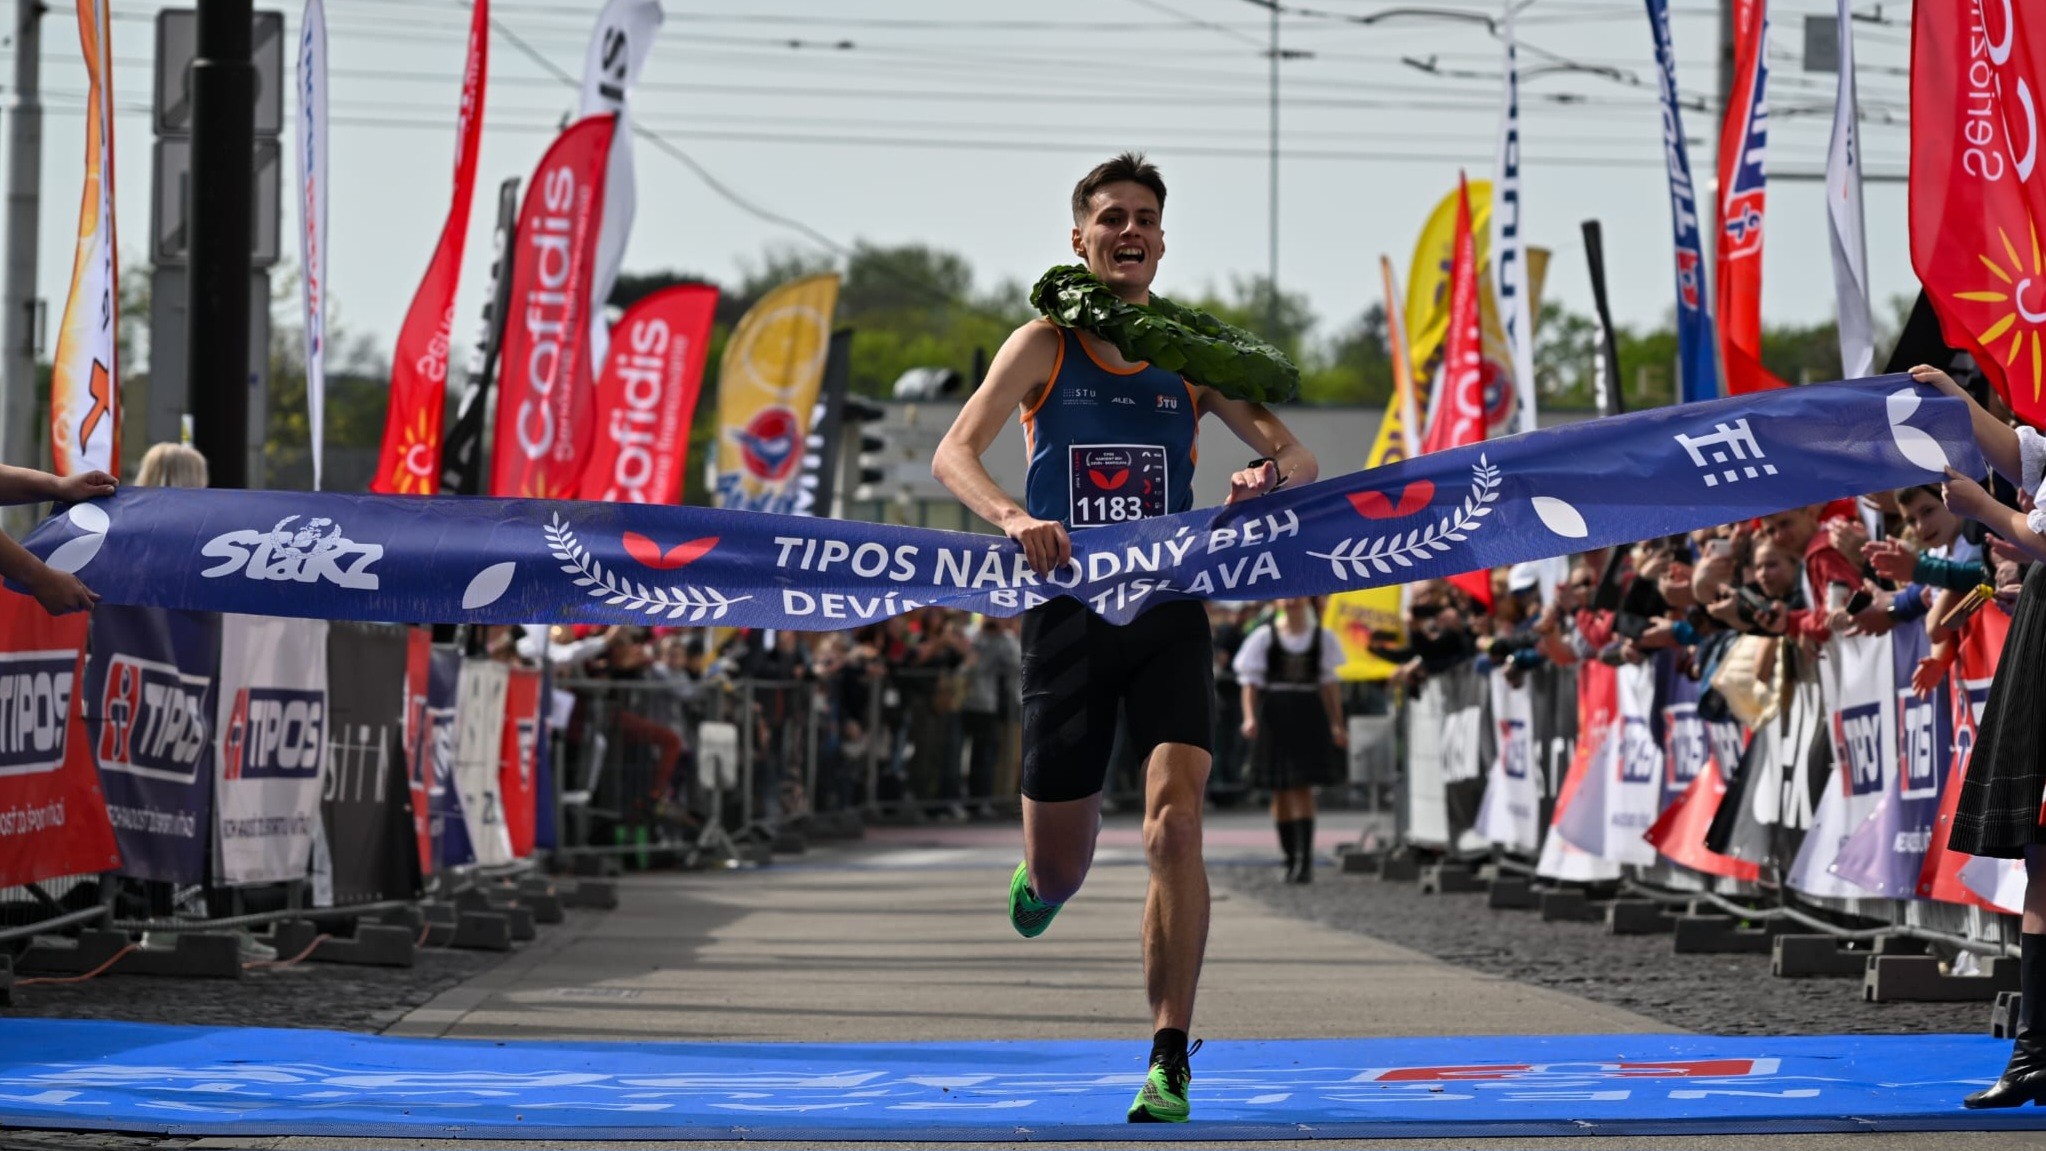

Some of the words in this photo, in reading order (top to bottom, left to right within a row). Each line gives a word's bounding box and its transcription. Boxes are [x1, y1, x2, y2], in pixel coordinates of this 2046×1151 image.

[515, 165, 575, 461] Cofidis
[1077, 496, 1142, 521] 1183
[774, 536, 919, 581] TIPOS
[933, 526, 1196, 589] NÁRODNÝ
[1207, 509, 1300, 555] BEH
[0, 671, 74, 753] TIPOS
[249, 699, 321, 769] TIPOS
